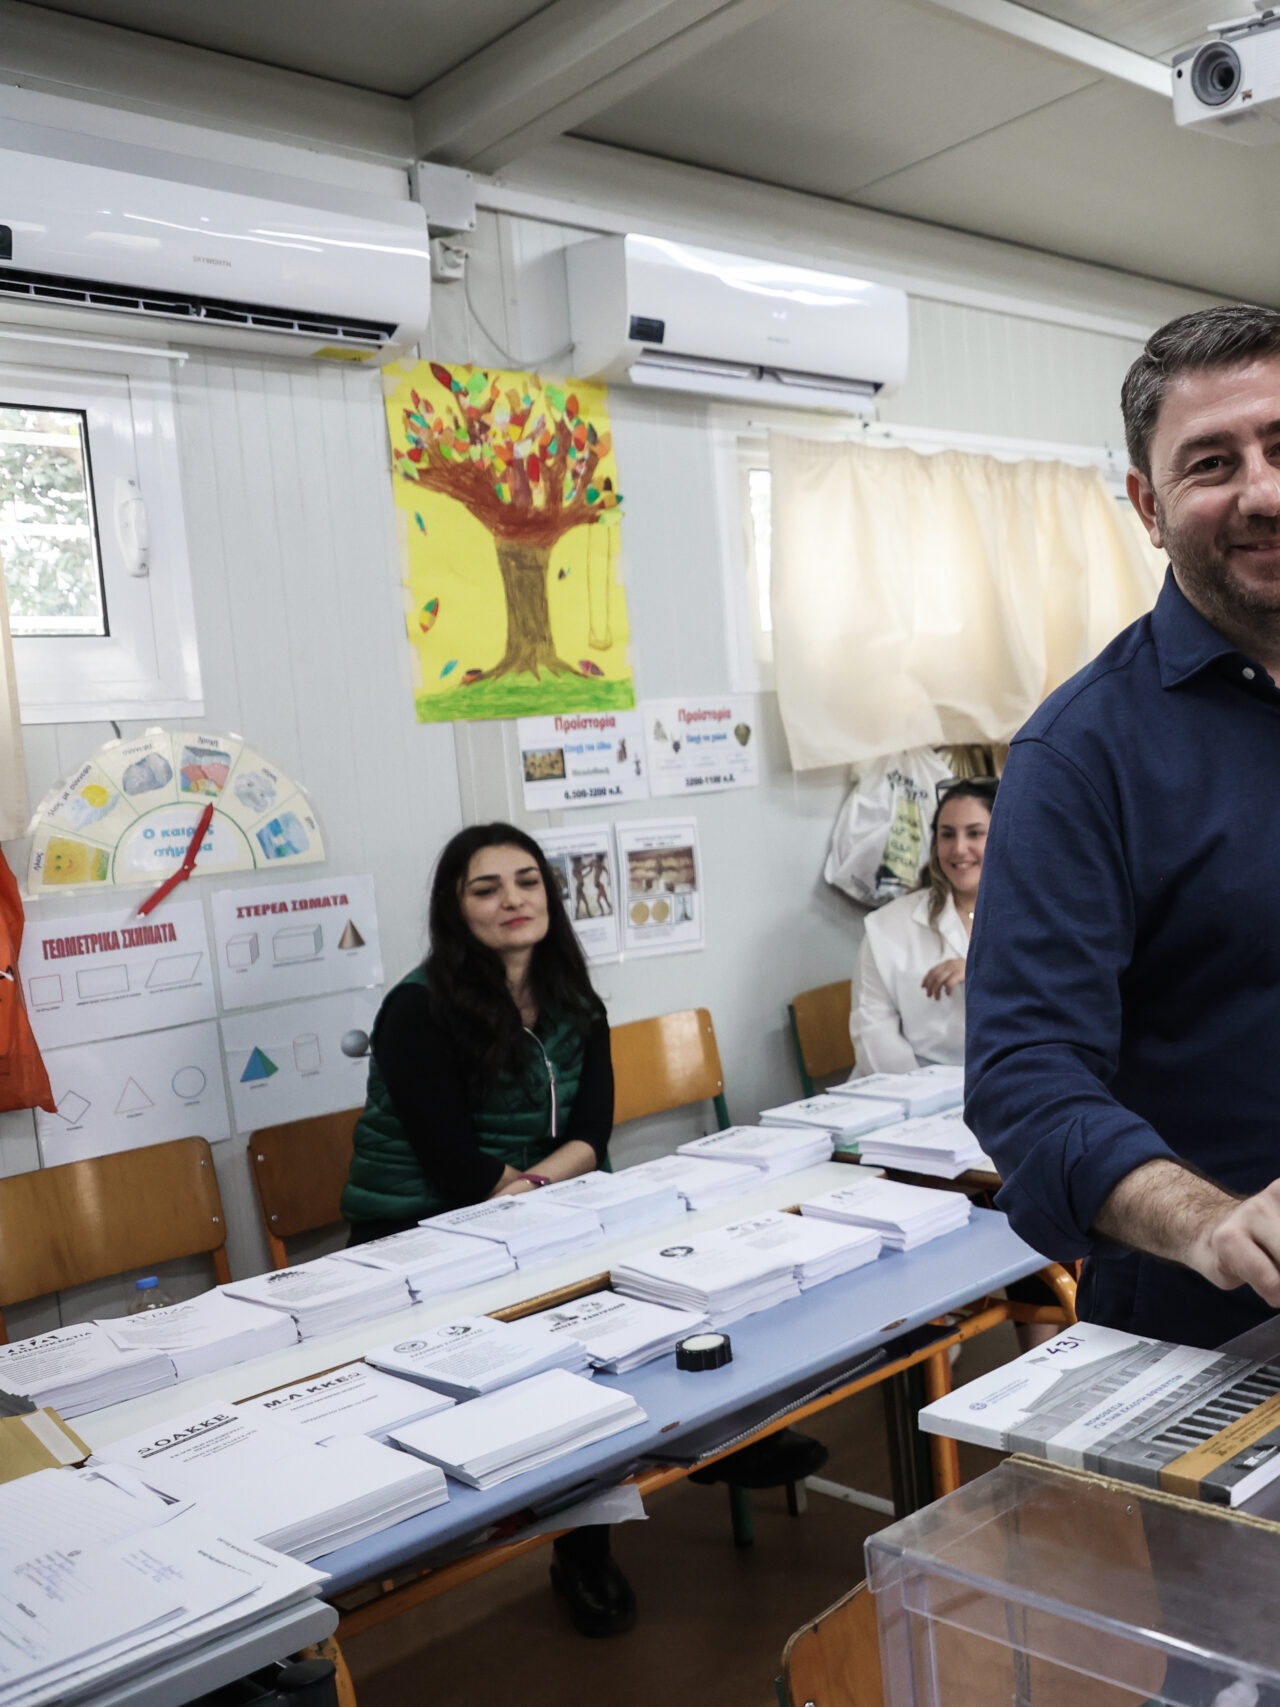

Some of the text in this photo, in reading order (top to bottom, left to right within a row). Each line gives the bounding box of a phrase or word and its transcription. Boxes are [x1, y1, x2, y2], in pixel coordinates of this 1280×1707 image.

[161, 824, 215, 838] καιρς
[236, 893, 349, 919] ΣΤΕΡΕΑ ΣΩΜΑΤΑ
[42, 922, 177, 960] ΓΕΩΜΕΤΡΙΚΑ ΣΧΗΜΑΤΑ
[306, 1375, 350, 1394] ΚΚΕ
[154, 1413, 229, 1447] ΟΑΚΚΕ
